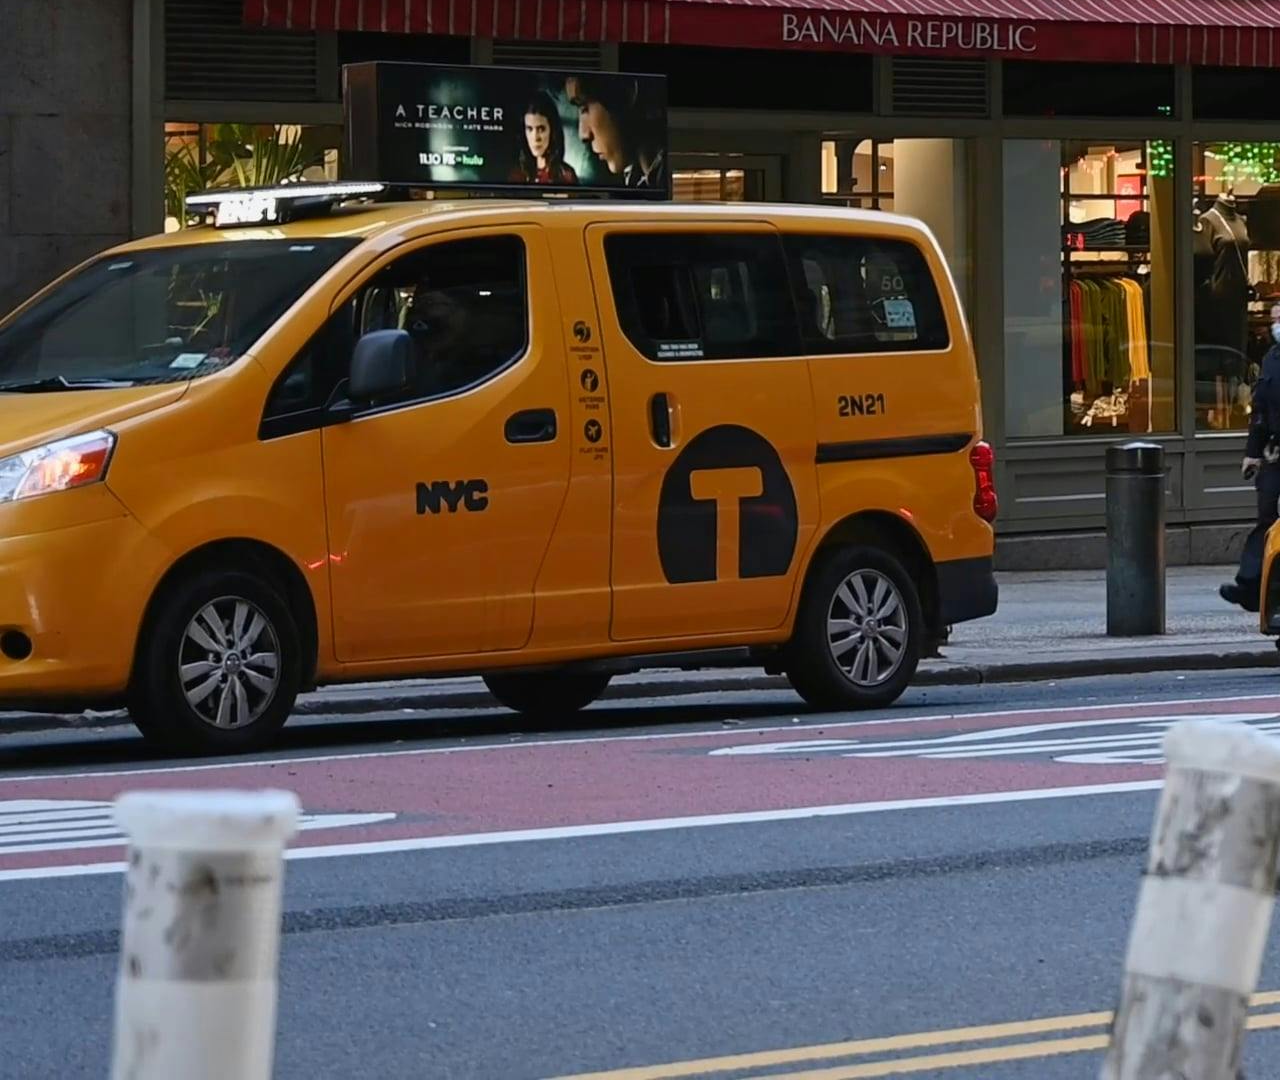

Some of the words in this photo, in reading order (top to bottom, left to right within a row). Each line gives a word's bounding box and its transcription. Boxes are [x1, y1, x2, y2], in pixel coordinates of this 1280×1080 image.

[782, 14, 899, 46] BANANA
[907, 20, 1037, 51] REPUBLIC
[395, 103, 406, 118] A
[416, 104, 503, 120] TEACHER
[837, 393, 885, 417] 2N21
[416, 478, 489, 514] NYC
[689, 465, 764, 581] T
